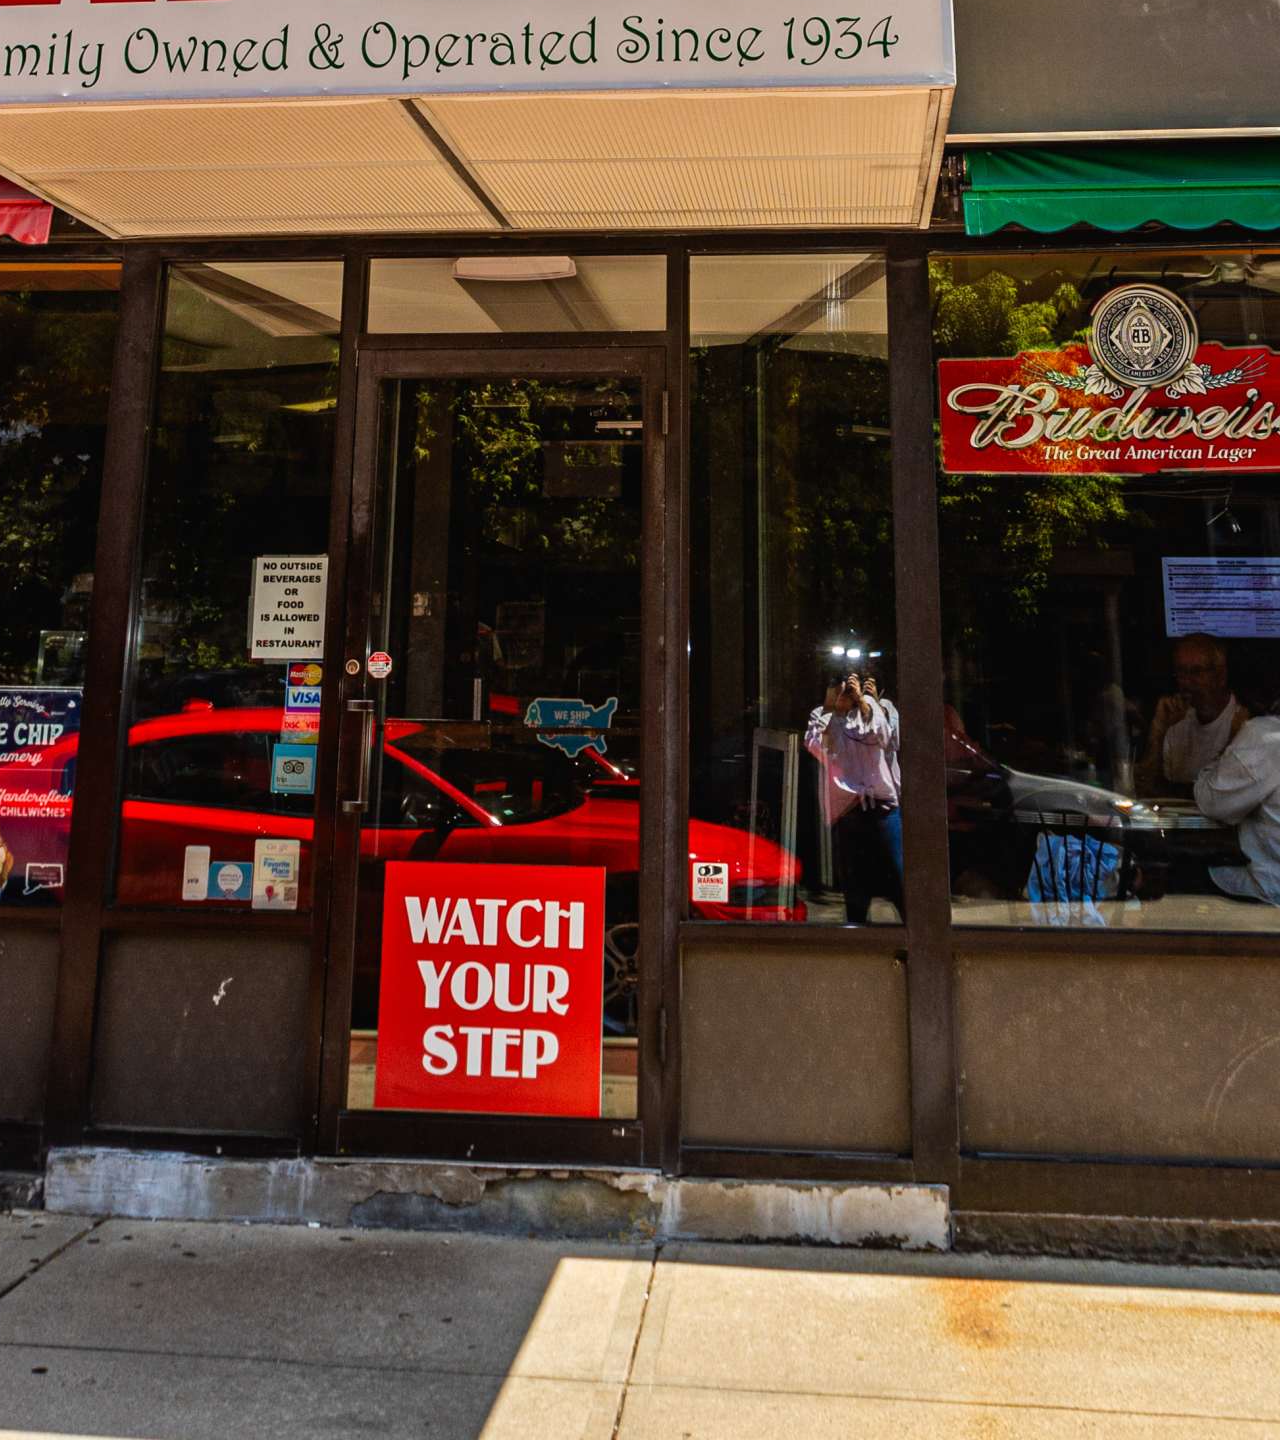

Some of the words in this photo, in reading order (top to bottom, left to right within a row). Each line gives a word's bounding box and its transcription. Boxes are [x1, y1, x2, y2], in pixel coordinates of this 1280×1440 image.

[123, 23, 291, 78] Owned
[307, 22, 346, 72] &
[361, 17, 598, 81] Operated
[616, 15, 765, 67] Since
[782, 14, 900, 62] 1934
[1131, 328, 1151, 344] AB
[1043, 445, 1074, 461] The
[1076, 445, 1120, 461] Great
[1125, 444, 1203, 461] American
[1207, 445, 1257, 464] Lager
[263, 562, 278, 570] NO
[280, 562, 323, 570] OUTSIDE
[262, 575, 322, 583] BEVERAGES
[284, 588, 299, 596] OR
[277, 601, 304, 609] FOOD
[260, 614, 270, 622] IS
[272, 614, 320, 622] ALLOWED
[283, 626, 295, 635] IN
[255, 640, 322, 648] RESTAURANT
[291, 690, 321, 704] VISA
[553, 710, 568, 720] WE
[569, 710, 591, 721] SHIP
[13, 722, 65, 746] CHIP
[404, 896, 585, 950] WATCH
[417, 959, 570, 1017] YOUR
[421, 1024, 560, 1079] STEP
